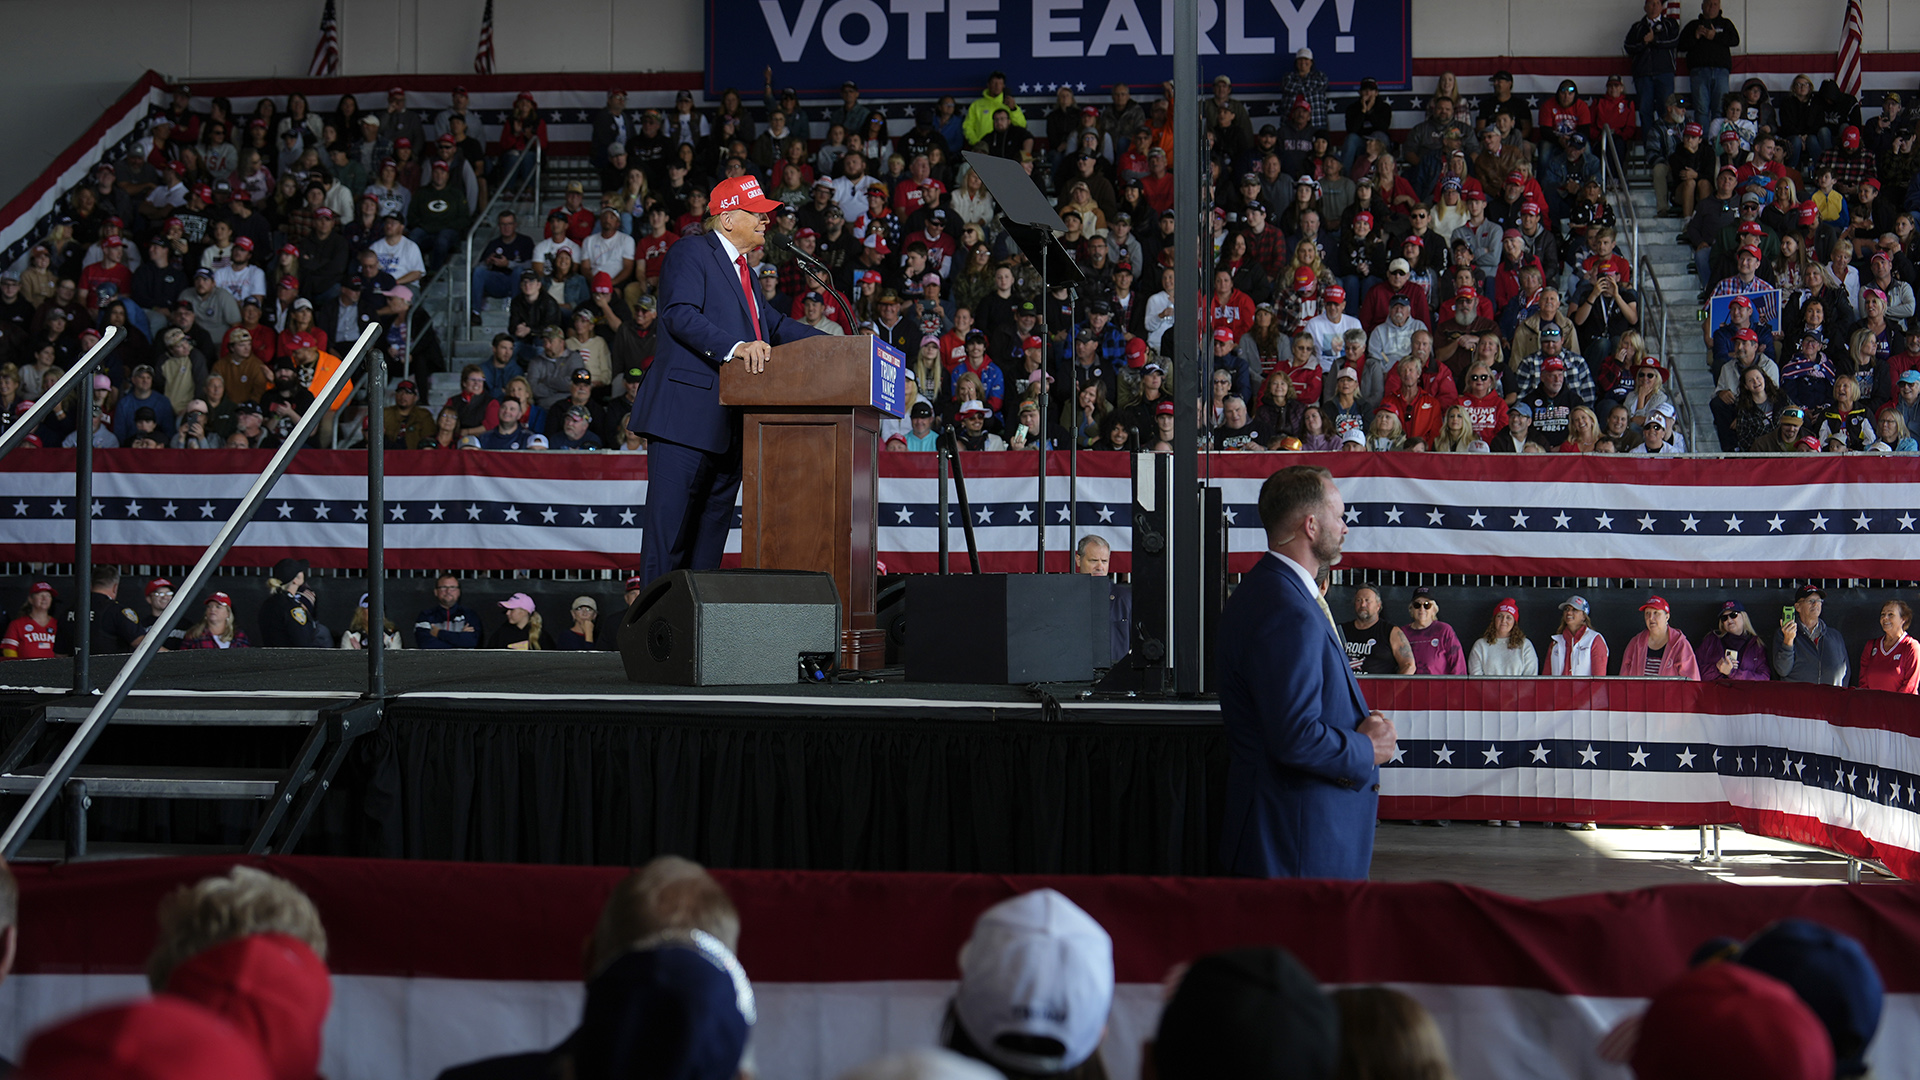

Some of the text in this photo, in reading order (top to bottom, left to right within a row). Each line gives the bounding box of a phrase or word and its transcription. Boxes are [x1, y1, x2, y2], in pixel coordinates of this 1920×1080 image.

[757, 0, 1355, 62] VOTE EARLY!
[720, 195, 739, 209] 45-47
[881, 360, 897, 384] TRUMP
[882, 379, 895, 398] VANCE
[1470, 414, 1496, 425] 024
[24, 632, 56, 643] TRUM
[1344, 642, 1373, 655] ROUD
